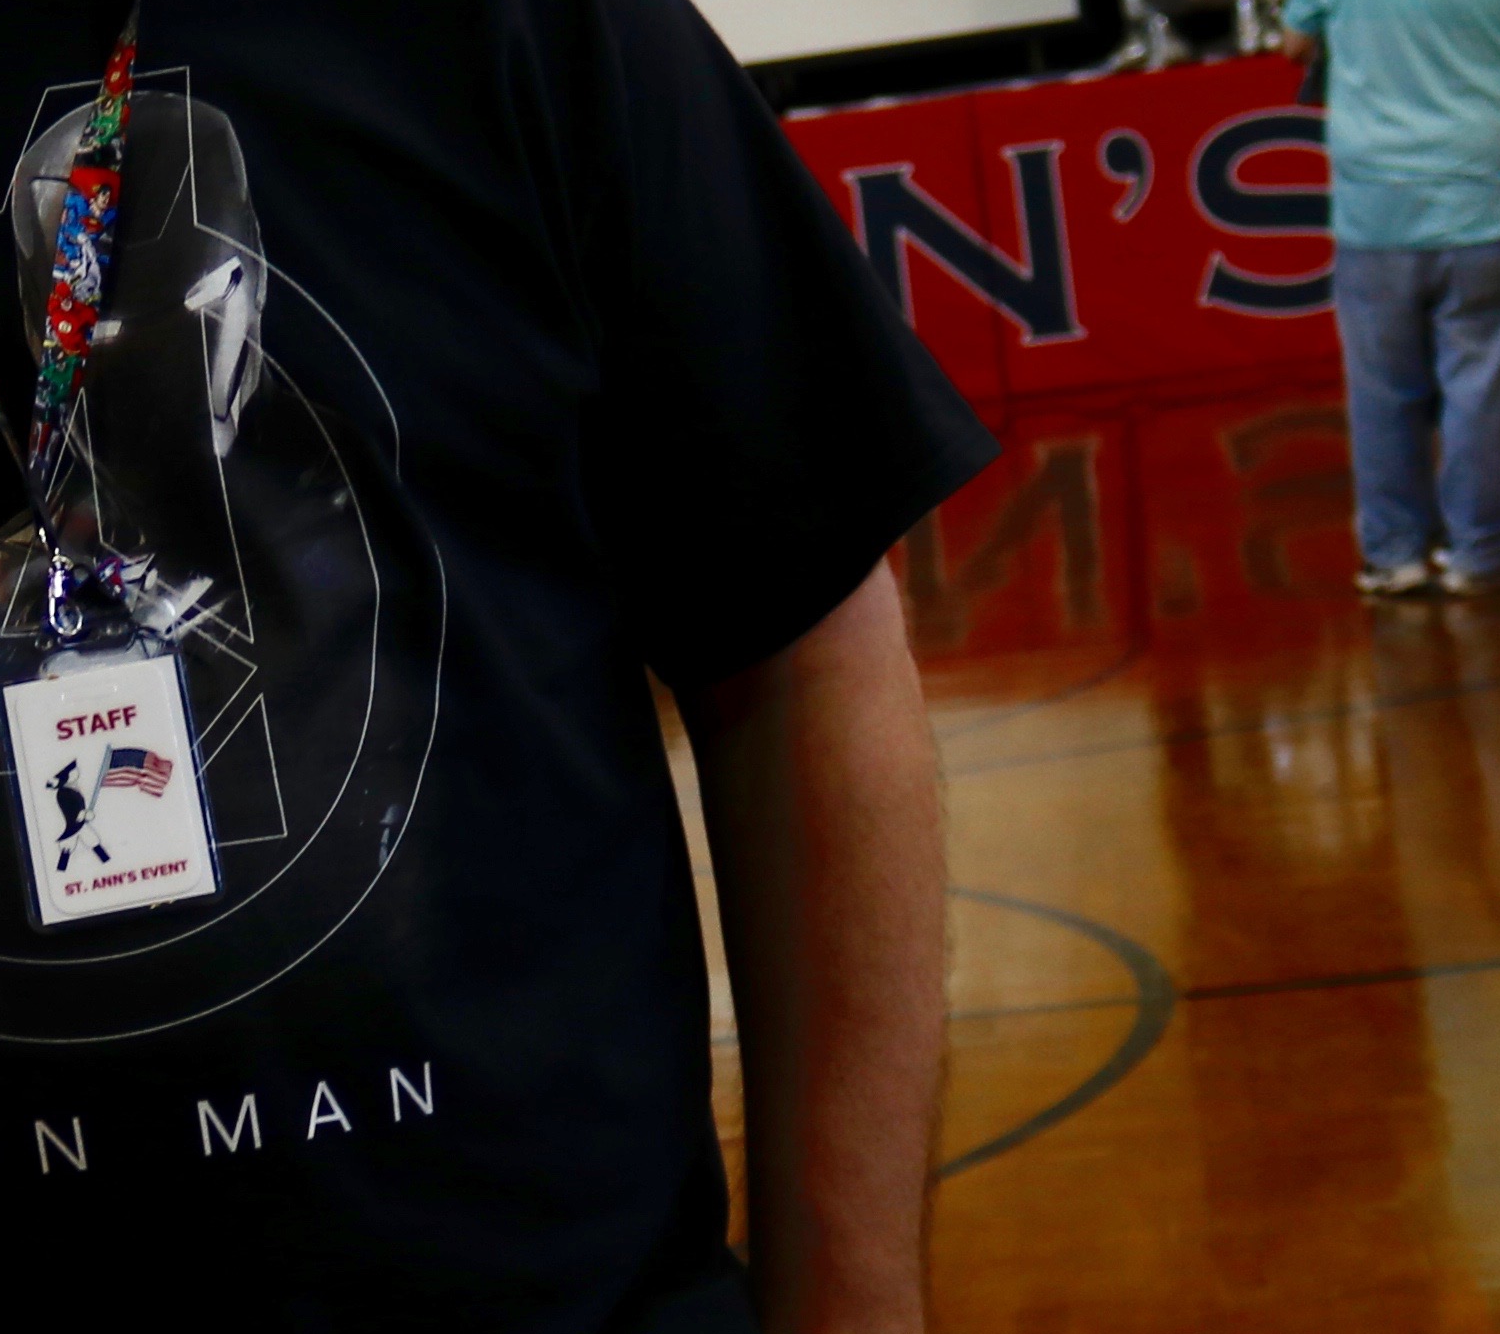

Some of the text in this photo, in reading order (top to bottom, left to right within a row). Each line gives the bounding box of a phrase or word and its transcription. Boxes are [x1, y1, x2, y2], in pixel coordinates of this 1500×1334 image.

[56, 704, 137, 741] STAFF
[64, 860, 188, 896] ST. ANN'S EVENT
[197, 1061, 434, 1157] MAN
